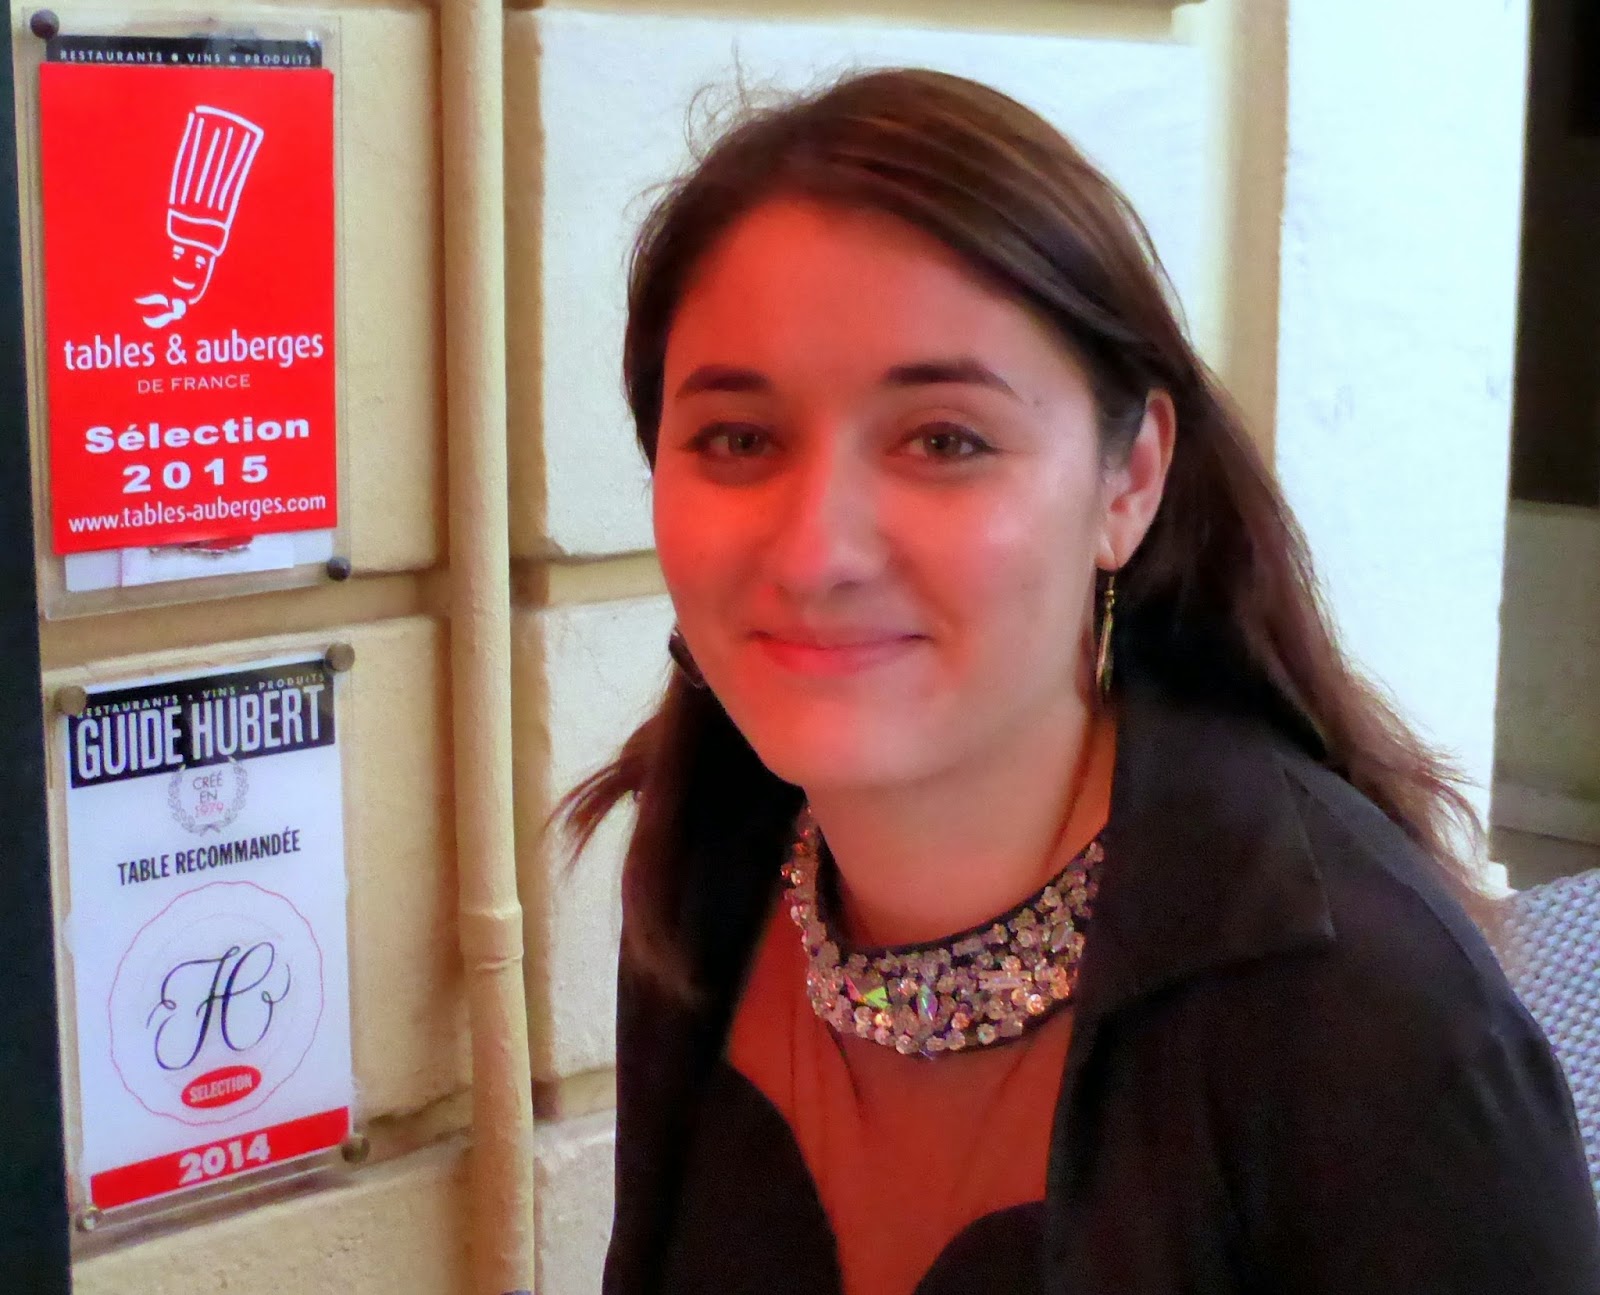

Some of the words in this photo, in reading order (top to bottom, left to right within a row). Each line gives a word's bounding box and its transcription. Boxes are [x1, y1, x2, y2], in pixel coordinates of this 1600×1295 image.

[60, 50, 163, 62] RESTAURANTS
[187, 53, 221, 64] VINS
[244, 53, 312, 66] PRODUITS
[64, 334, 156, 371] tables
[166, 333, 188, 365] &
[195, 329, 325, 368] auberges
[137, 379, 164, 394] DE
[171, 374, 251, 391] FRANCE
[84, 416, 311, 454] Sélection
[122, 455, 269, 494] 2015
[67, 495, 327, 533] www.tables-auberges.com
[202, 686, 236, 699] VINS
[76, 705, 183, 780] GUIDE
[191, 685, 326, 760] HUBERT
[117, 852, 170, 886] TABLE
[175, 826, 301, 875] RECOMMANDÉE
[190, 1073, 252, 1103] SELECTION
[178, 1133, 271, 1184] 2014
